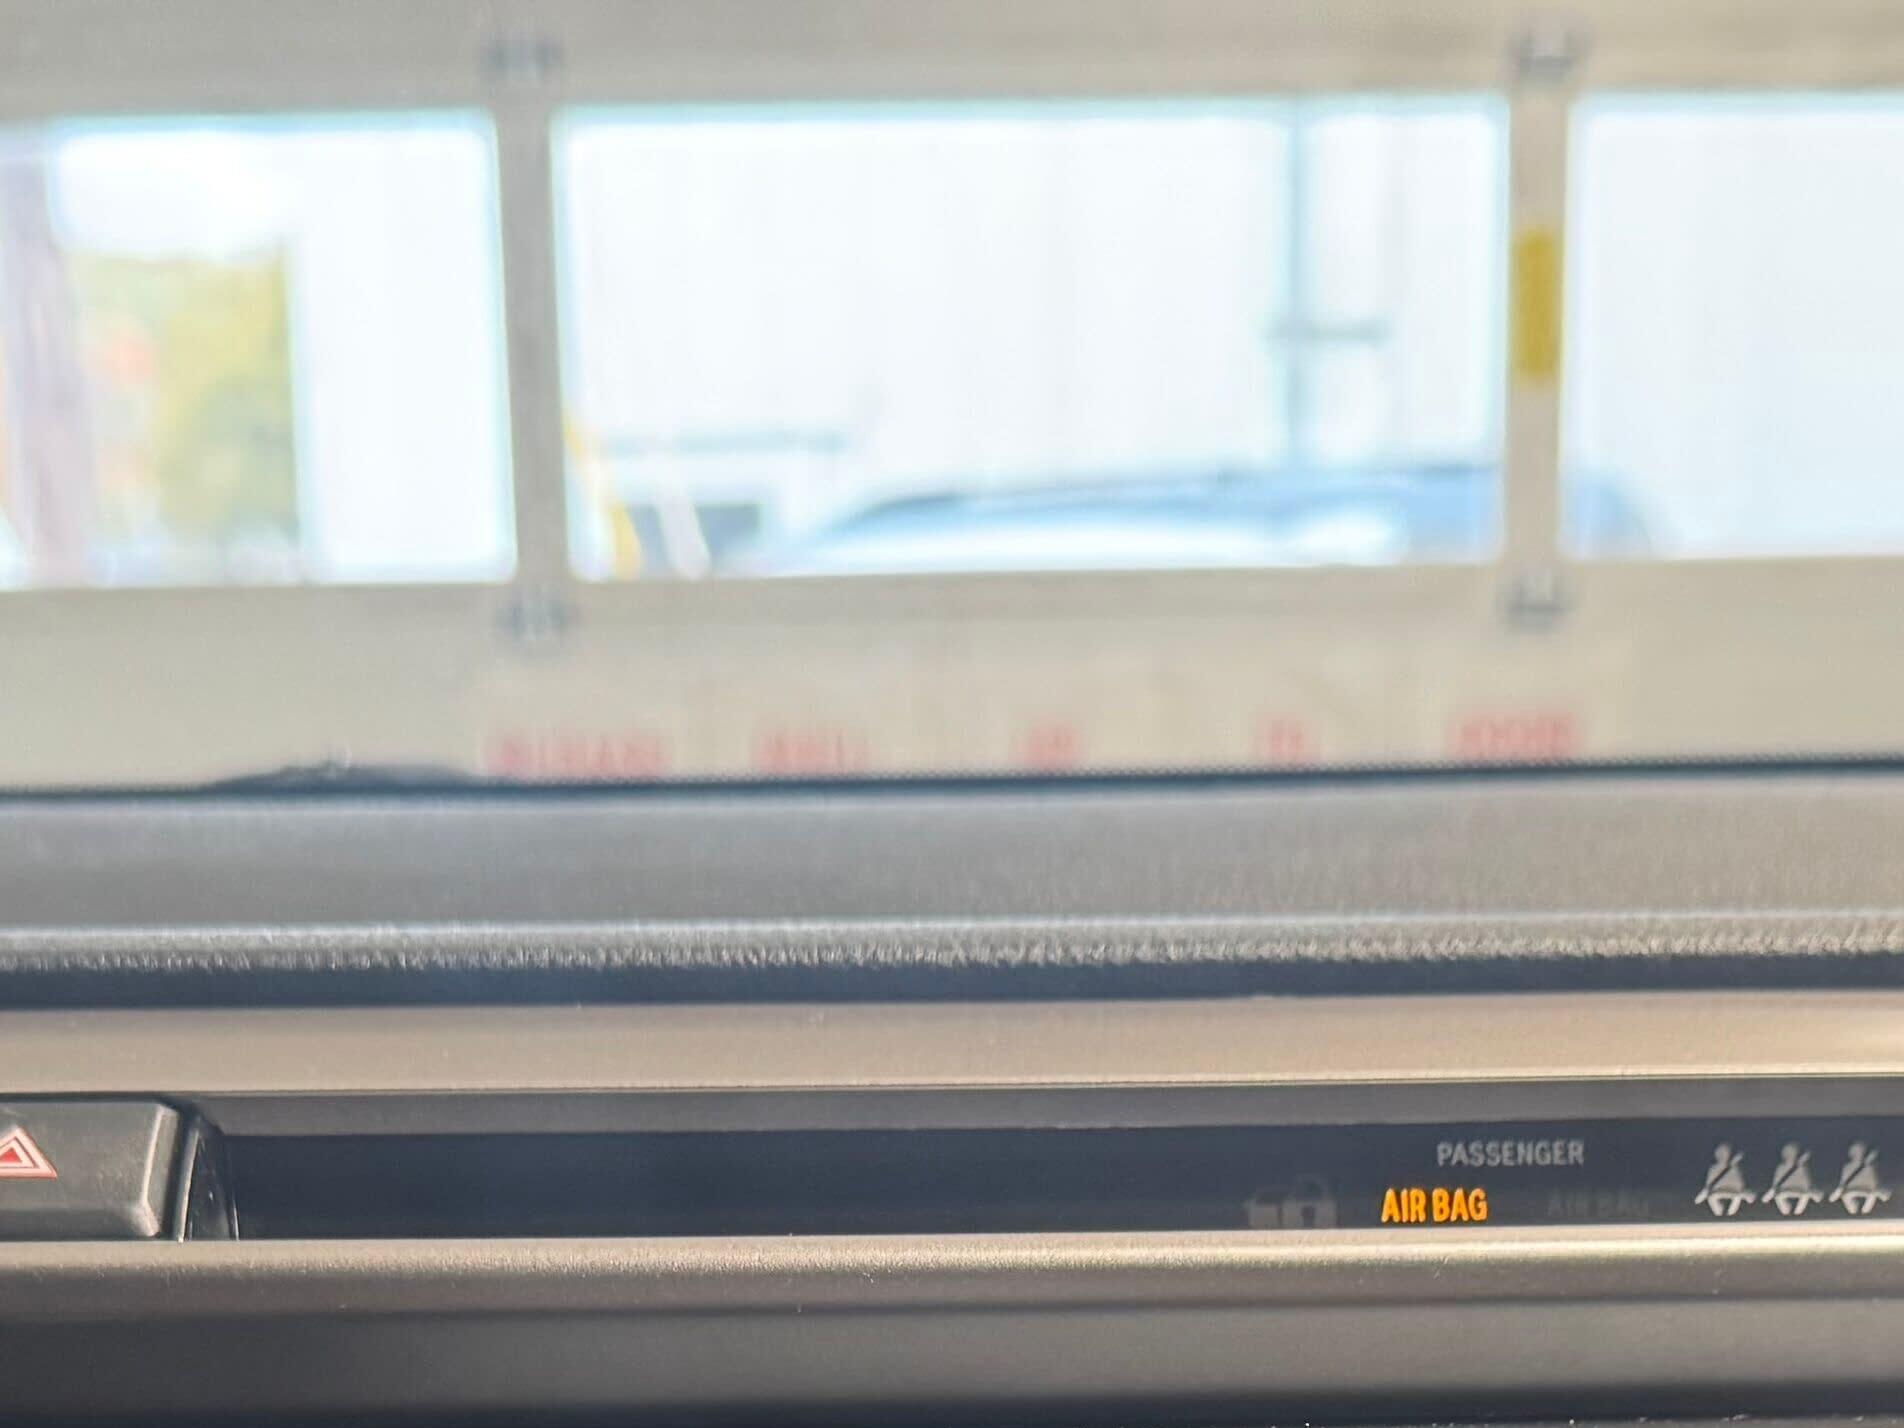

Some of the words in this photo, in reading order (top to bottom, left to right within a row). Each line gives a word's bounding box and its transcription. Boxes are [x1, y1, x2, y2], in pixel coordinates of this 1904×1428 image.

[1437, 1141, 1583, 1165] PASSENGER
[1382, 1189, 1426, 1222] AIR
[1433, 1189, 1487, 1221] BAG
